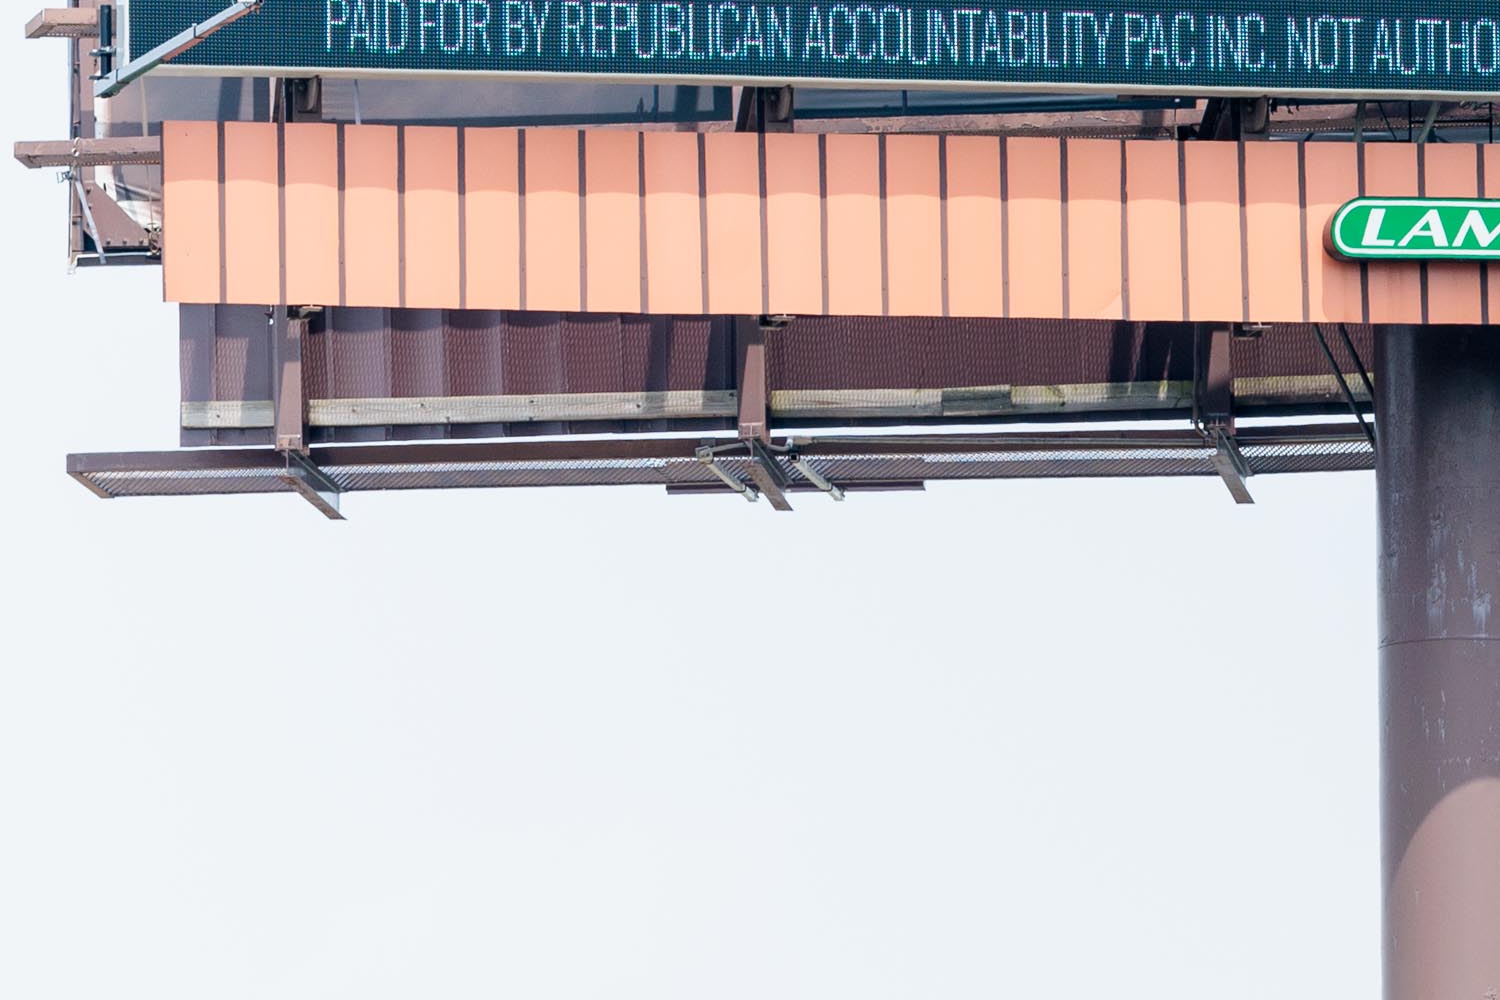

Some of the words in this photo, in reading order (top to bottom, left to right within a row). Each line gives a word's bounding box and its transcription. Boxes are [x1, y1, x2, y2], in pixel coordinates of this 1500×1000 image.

[504, 0, 551, 56] BY
[562, 1, 793, 61] REPUBLICAN
[803, 4, 1113, 67] ACCOUNTABILITY
[1125, 12, 1197, 70] PAC
[1206, 13, 1275, 72] INC.
[1287, 14, 1360, 73] NOT
